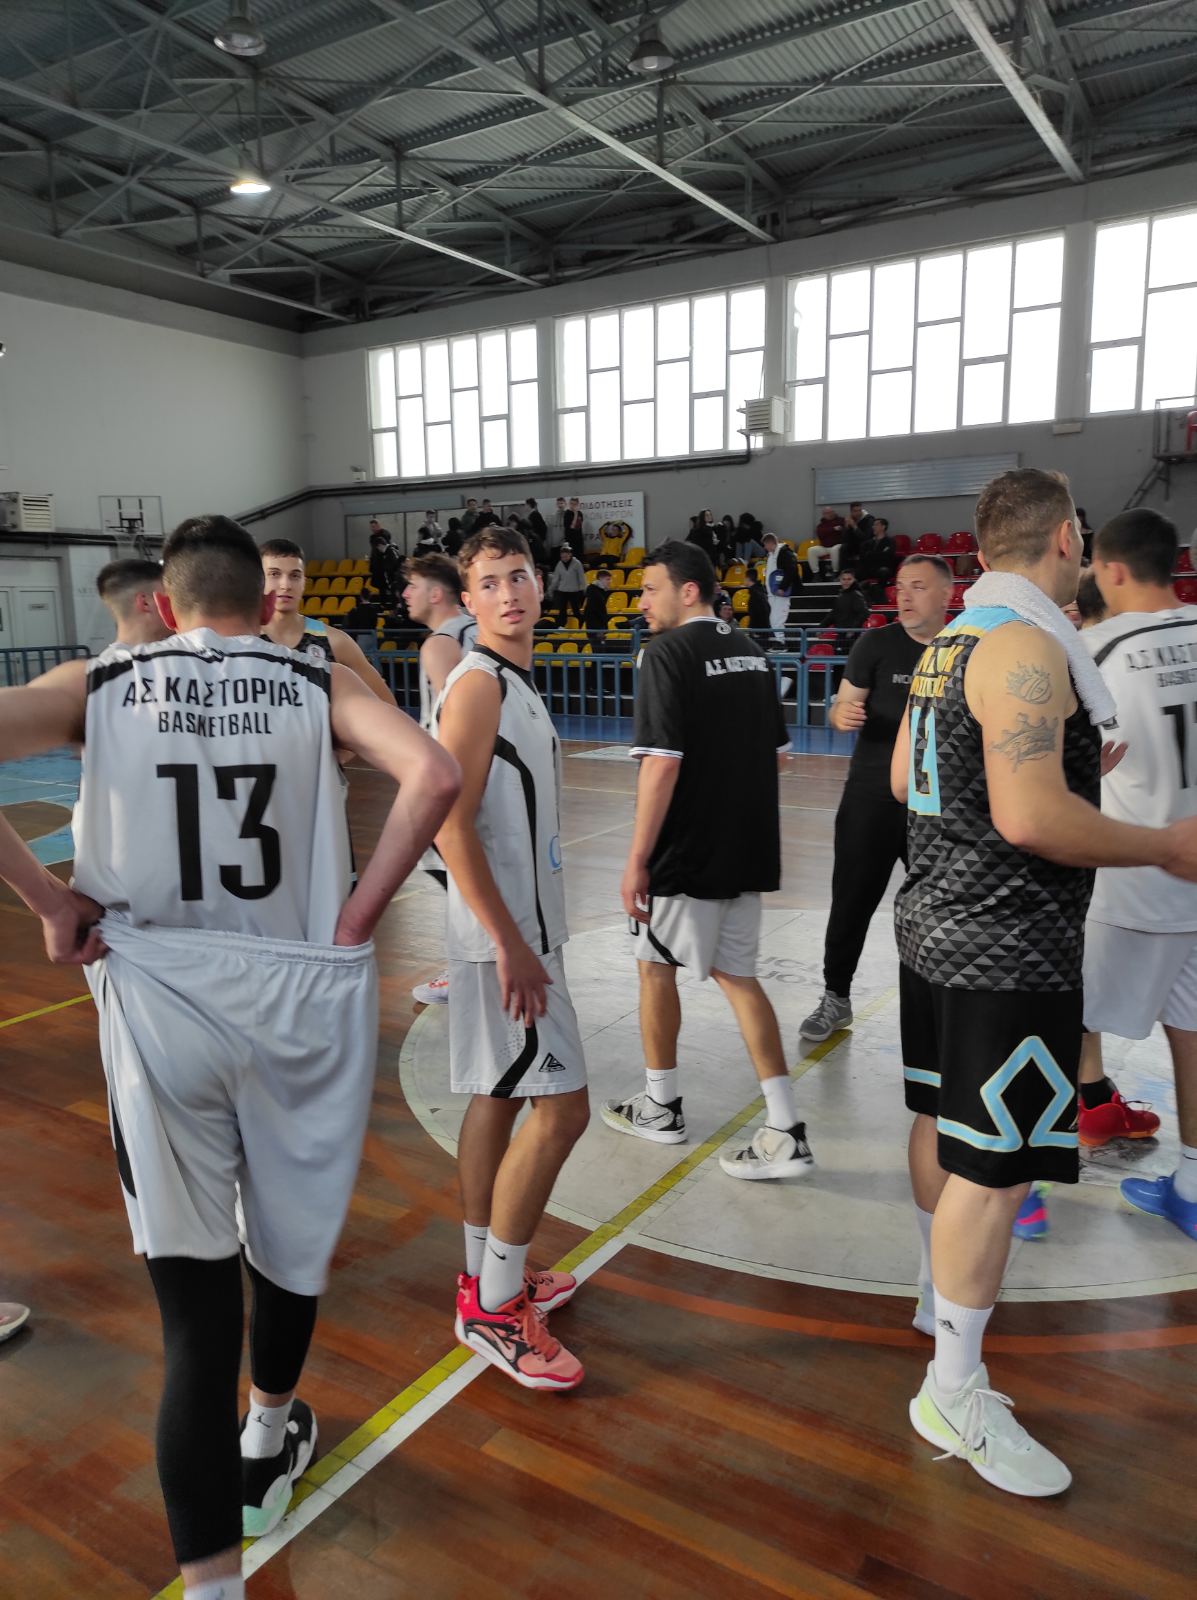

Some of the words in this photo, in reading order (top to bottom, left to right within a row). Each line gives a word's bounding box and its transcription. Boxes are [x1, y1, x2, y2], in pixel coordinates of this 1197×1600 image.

[165, 676, 304, 708] ΚΑΣΤΟΡΙΑΣ
[158, 711, 272, 737] BASKETBALL
[156, 764, 281, 901] 13
